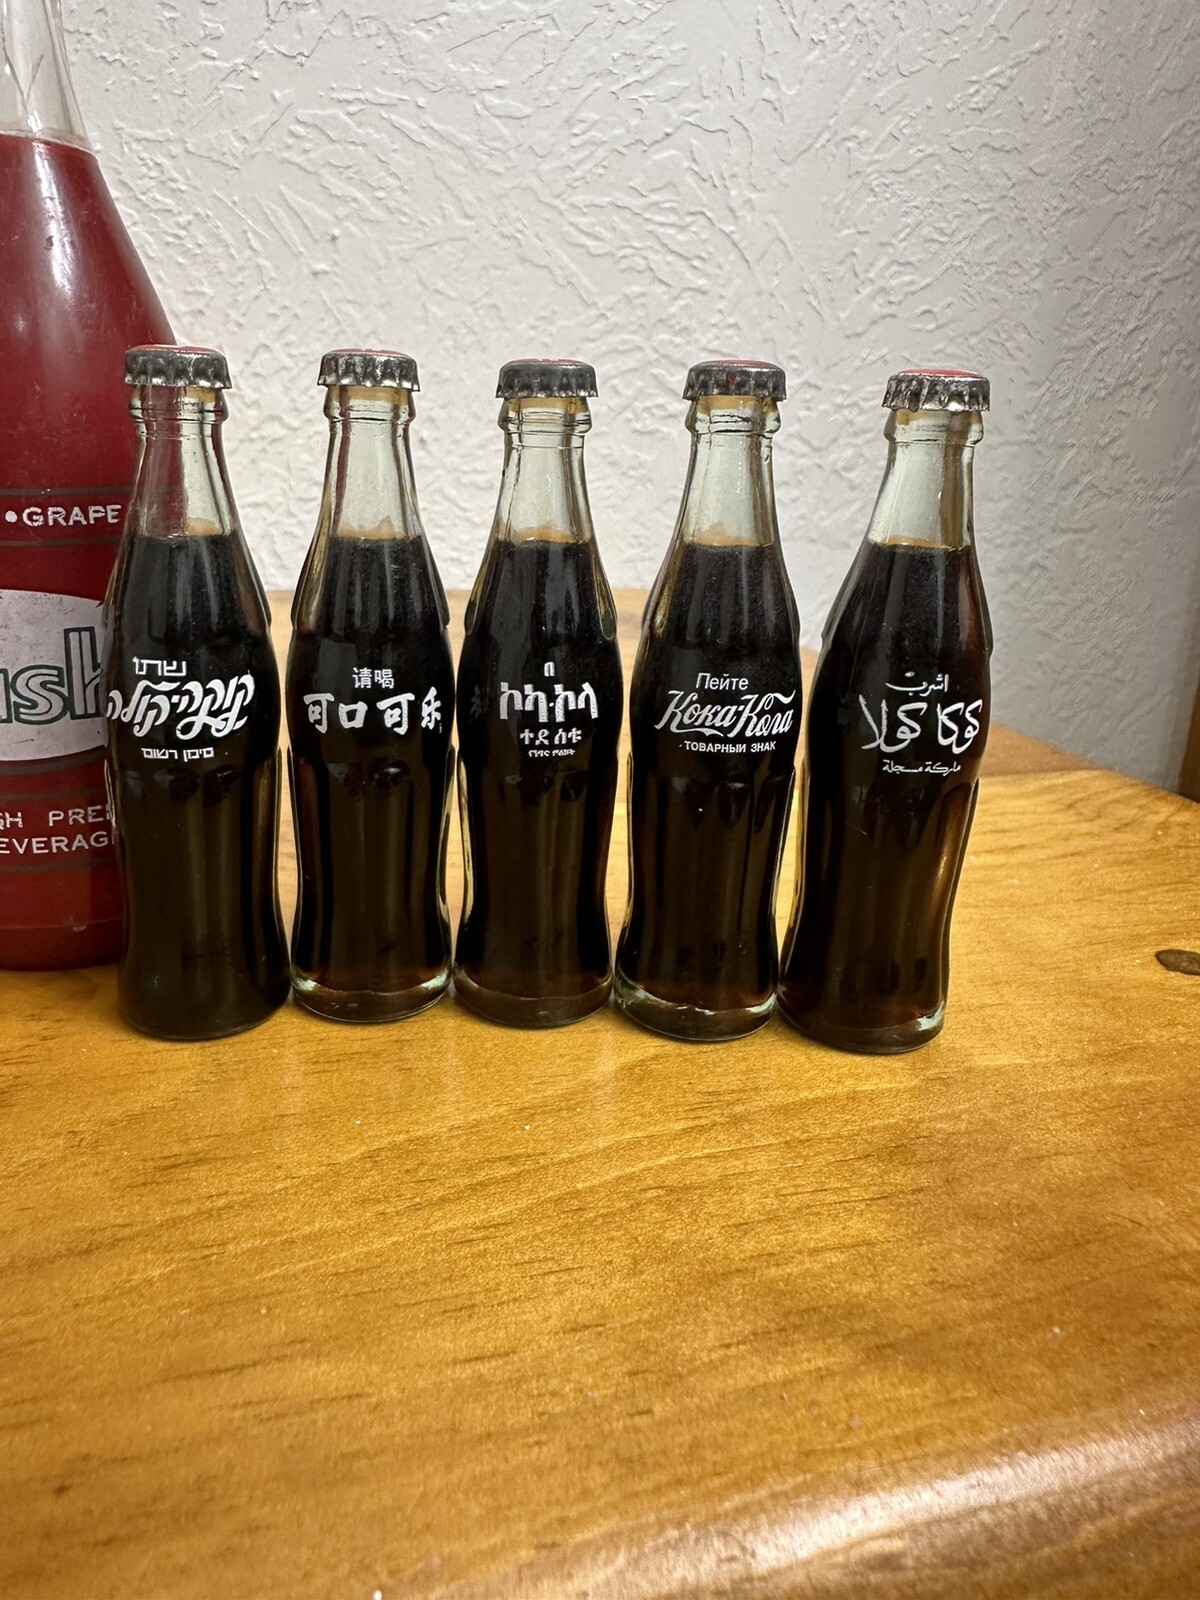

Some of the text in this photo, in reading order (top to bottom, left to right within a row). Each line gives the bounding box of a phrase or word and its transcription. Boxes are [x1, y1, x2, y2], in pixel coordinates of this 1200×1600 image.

[22, 504, 122, 526] GRAPE
[132, 656, 187, 677] שתו
[352, 667, 395, 689] 请喝
[695, 672, 749, 690] Пейте
[303, 686, 442, 736] 可口可乐
[654, 689, 796, 738] Кока-Кола
[750, 741, 776, 753] ЗНАК
[0, 831, 115, 854] EVERAG
